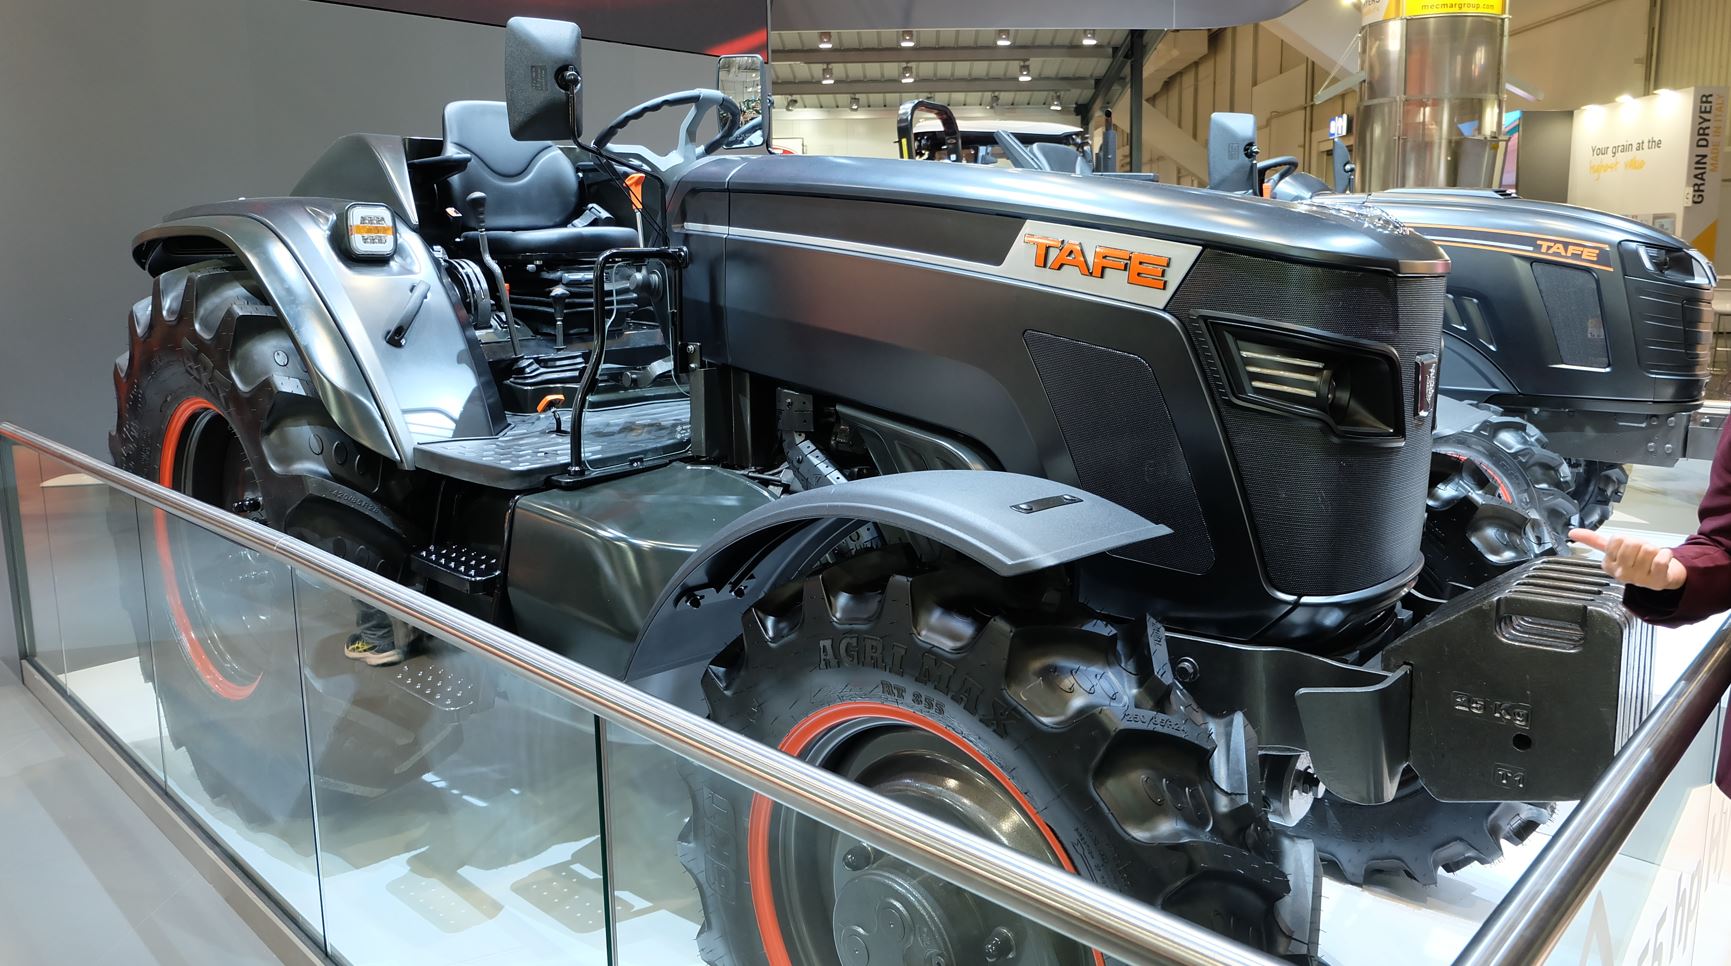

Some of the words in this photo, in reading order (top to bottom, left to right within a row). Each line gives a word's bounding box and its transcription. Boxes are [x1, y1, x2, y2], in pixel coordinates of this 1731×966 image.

[1421, 2, 1495, 11] mecmargroup.com
[1695, 93, 1713, 148] DRYER
[1591, 145, 1609, 157] Your
[1611, 140, 1633, 158] grain
[1635, 140, 1645, 151] at
[1647, 137, 1662, 150] the
[1691, 154, 1708, 205] GRAIN
[1024, 233, 1171, 290] TAFE
[1536, 240, 1600, 261] TAFE
[818, 635, 907, 678] AGRI
[915, 653, 1021, 739] MAX
[881, 680, 906, 700] RT
